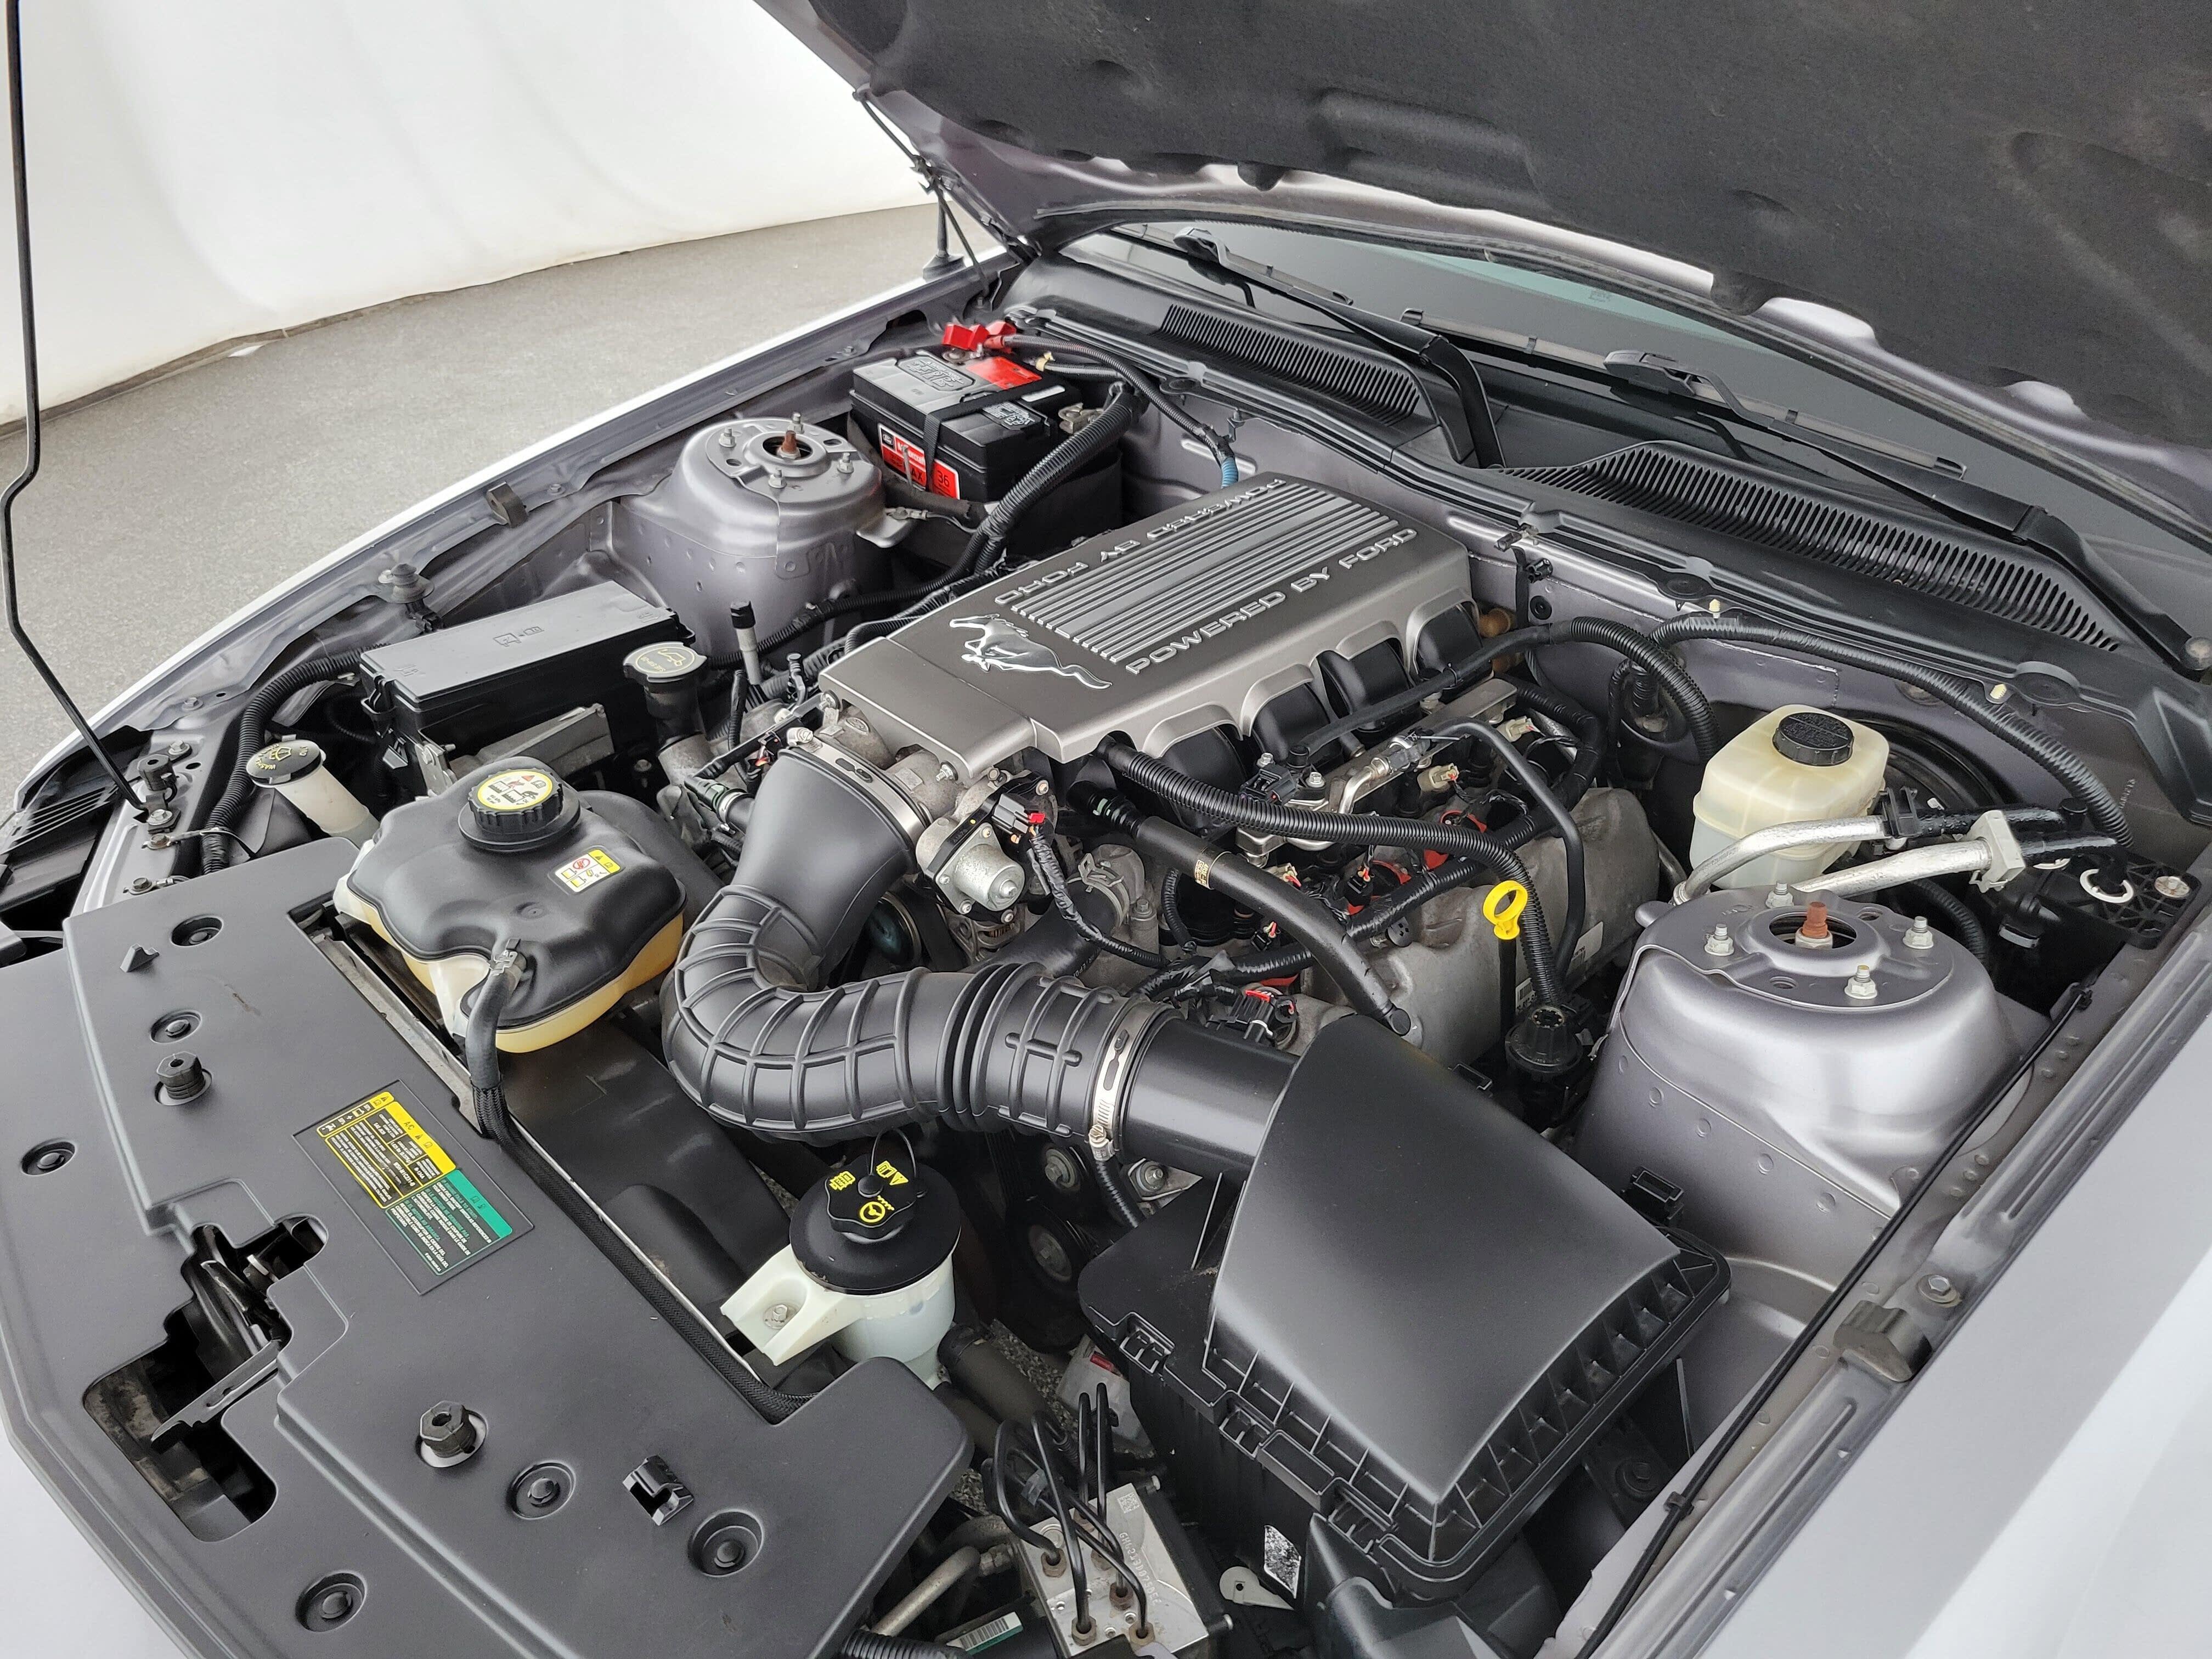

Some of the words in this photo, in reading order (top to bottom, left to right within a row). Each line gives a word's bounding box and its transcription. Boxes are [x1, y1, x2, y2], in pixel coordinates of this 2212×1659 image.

[937, 470, 950, 488] 36
[1147, 478, 1286, 540] POWERED
[1100, 539, 1141, 562] BY
[994, 561, 1090, 605] FORD
[1125, 590, 1286, 674] POWERED
[1290, 567, 1330, 592] BY
[1339, 528, 1418, 569] FORD
